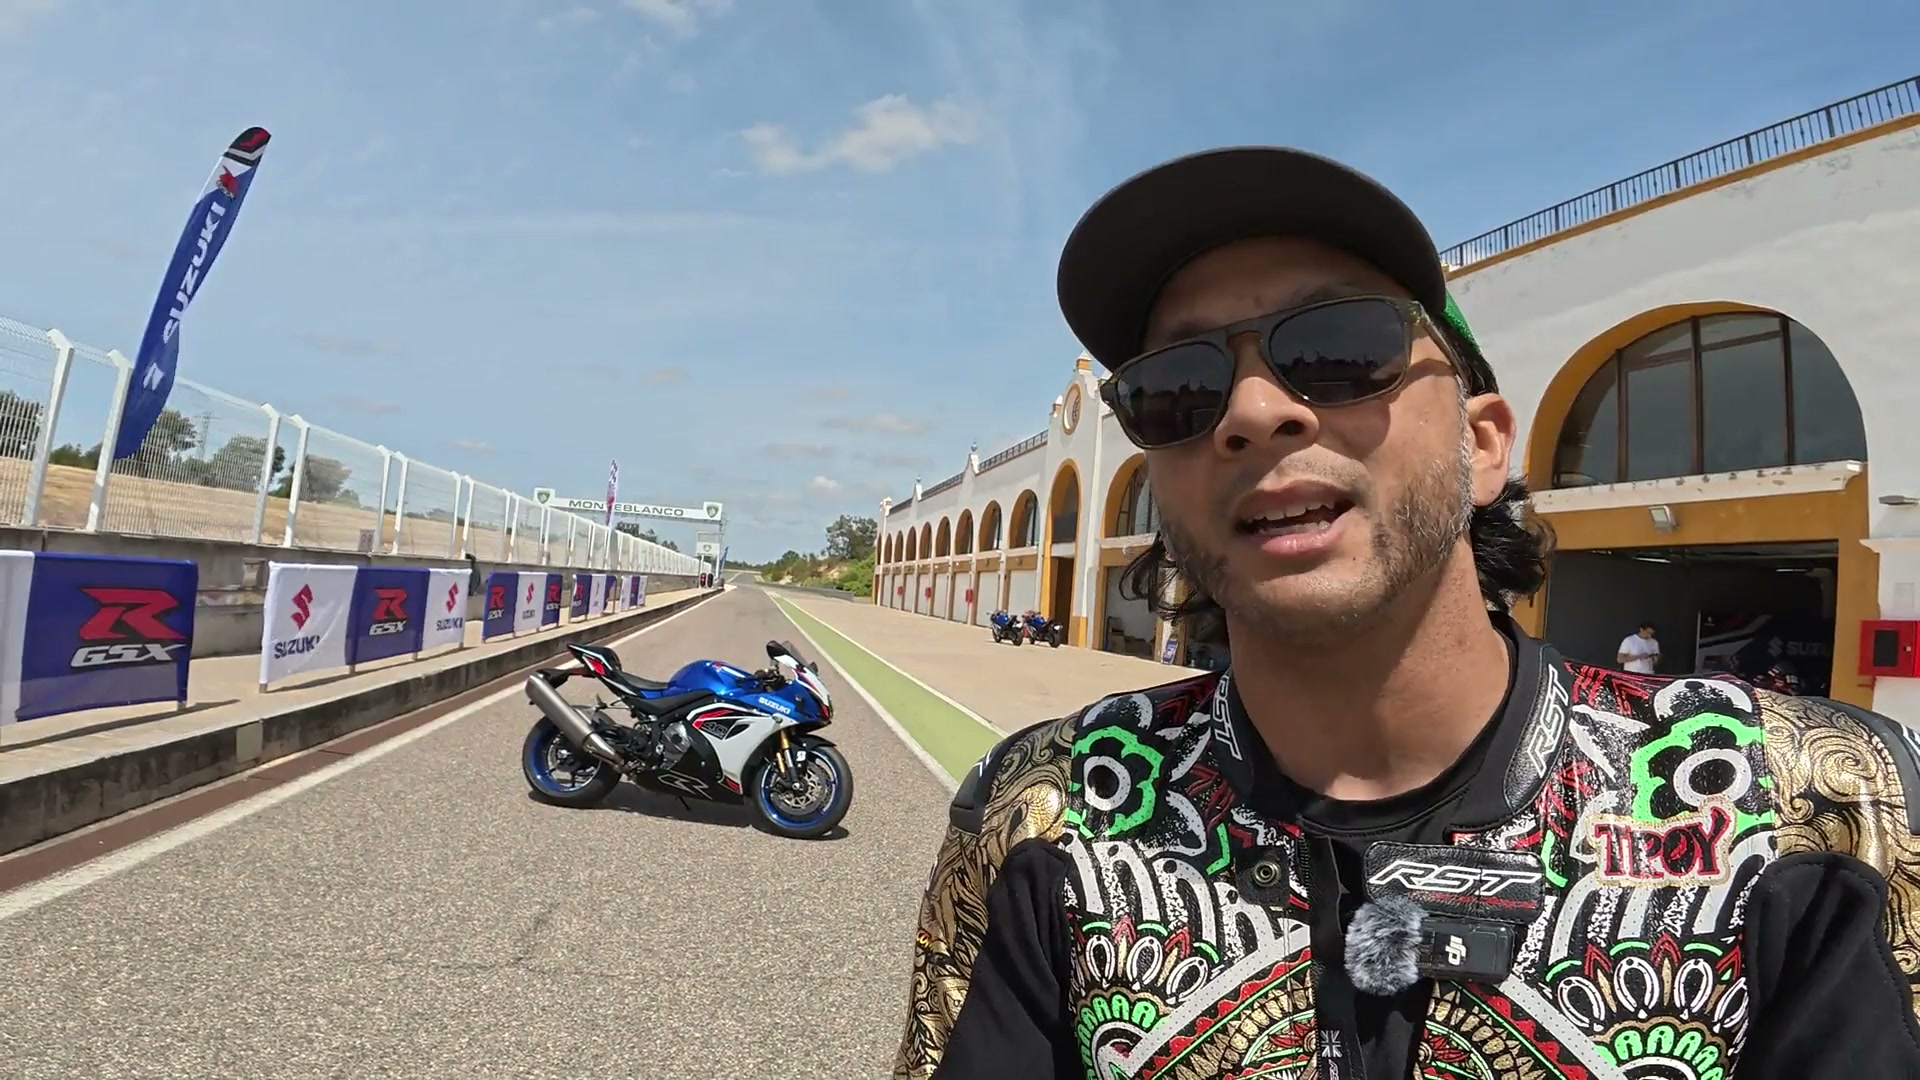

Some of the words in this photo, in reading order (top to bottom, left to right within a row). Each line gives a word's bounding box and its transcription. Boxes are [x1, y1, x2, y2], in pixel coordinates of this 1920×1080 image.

[163, 201, 226, 344] SUZUKI
[368, 620, 407, 636] GSX
[70, 643, 187, 668] GSX
[758, 696, 791, 714] SUZUKI
[1527, 663, 1569, 779] RST
[1368, 860, 1544, 896] RST
